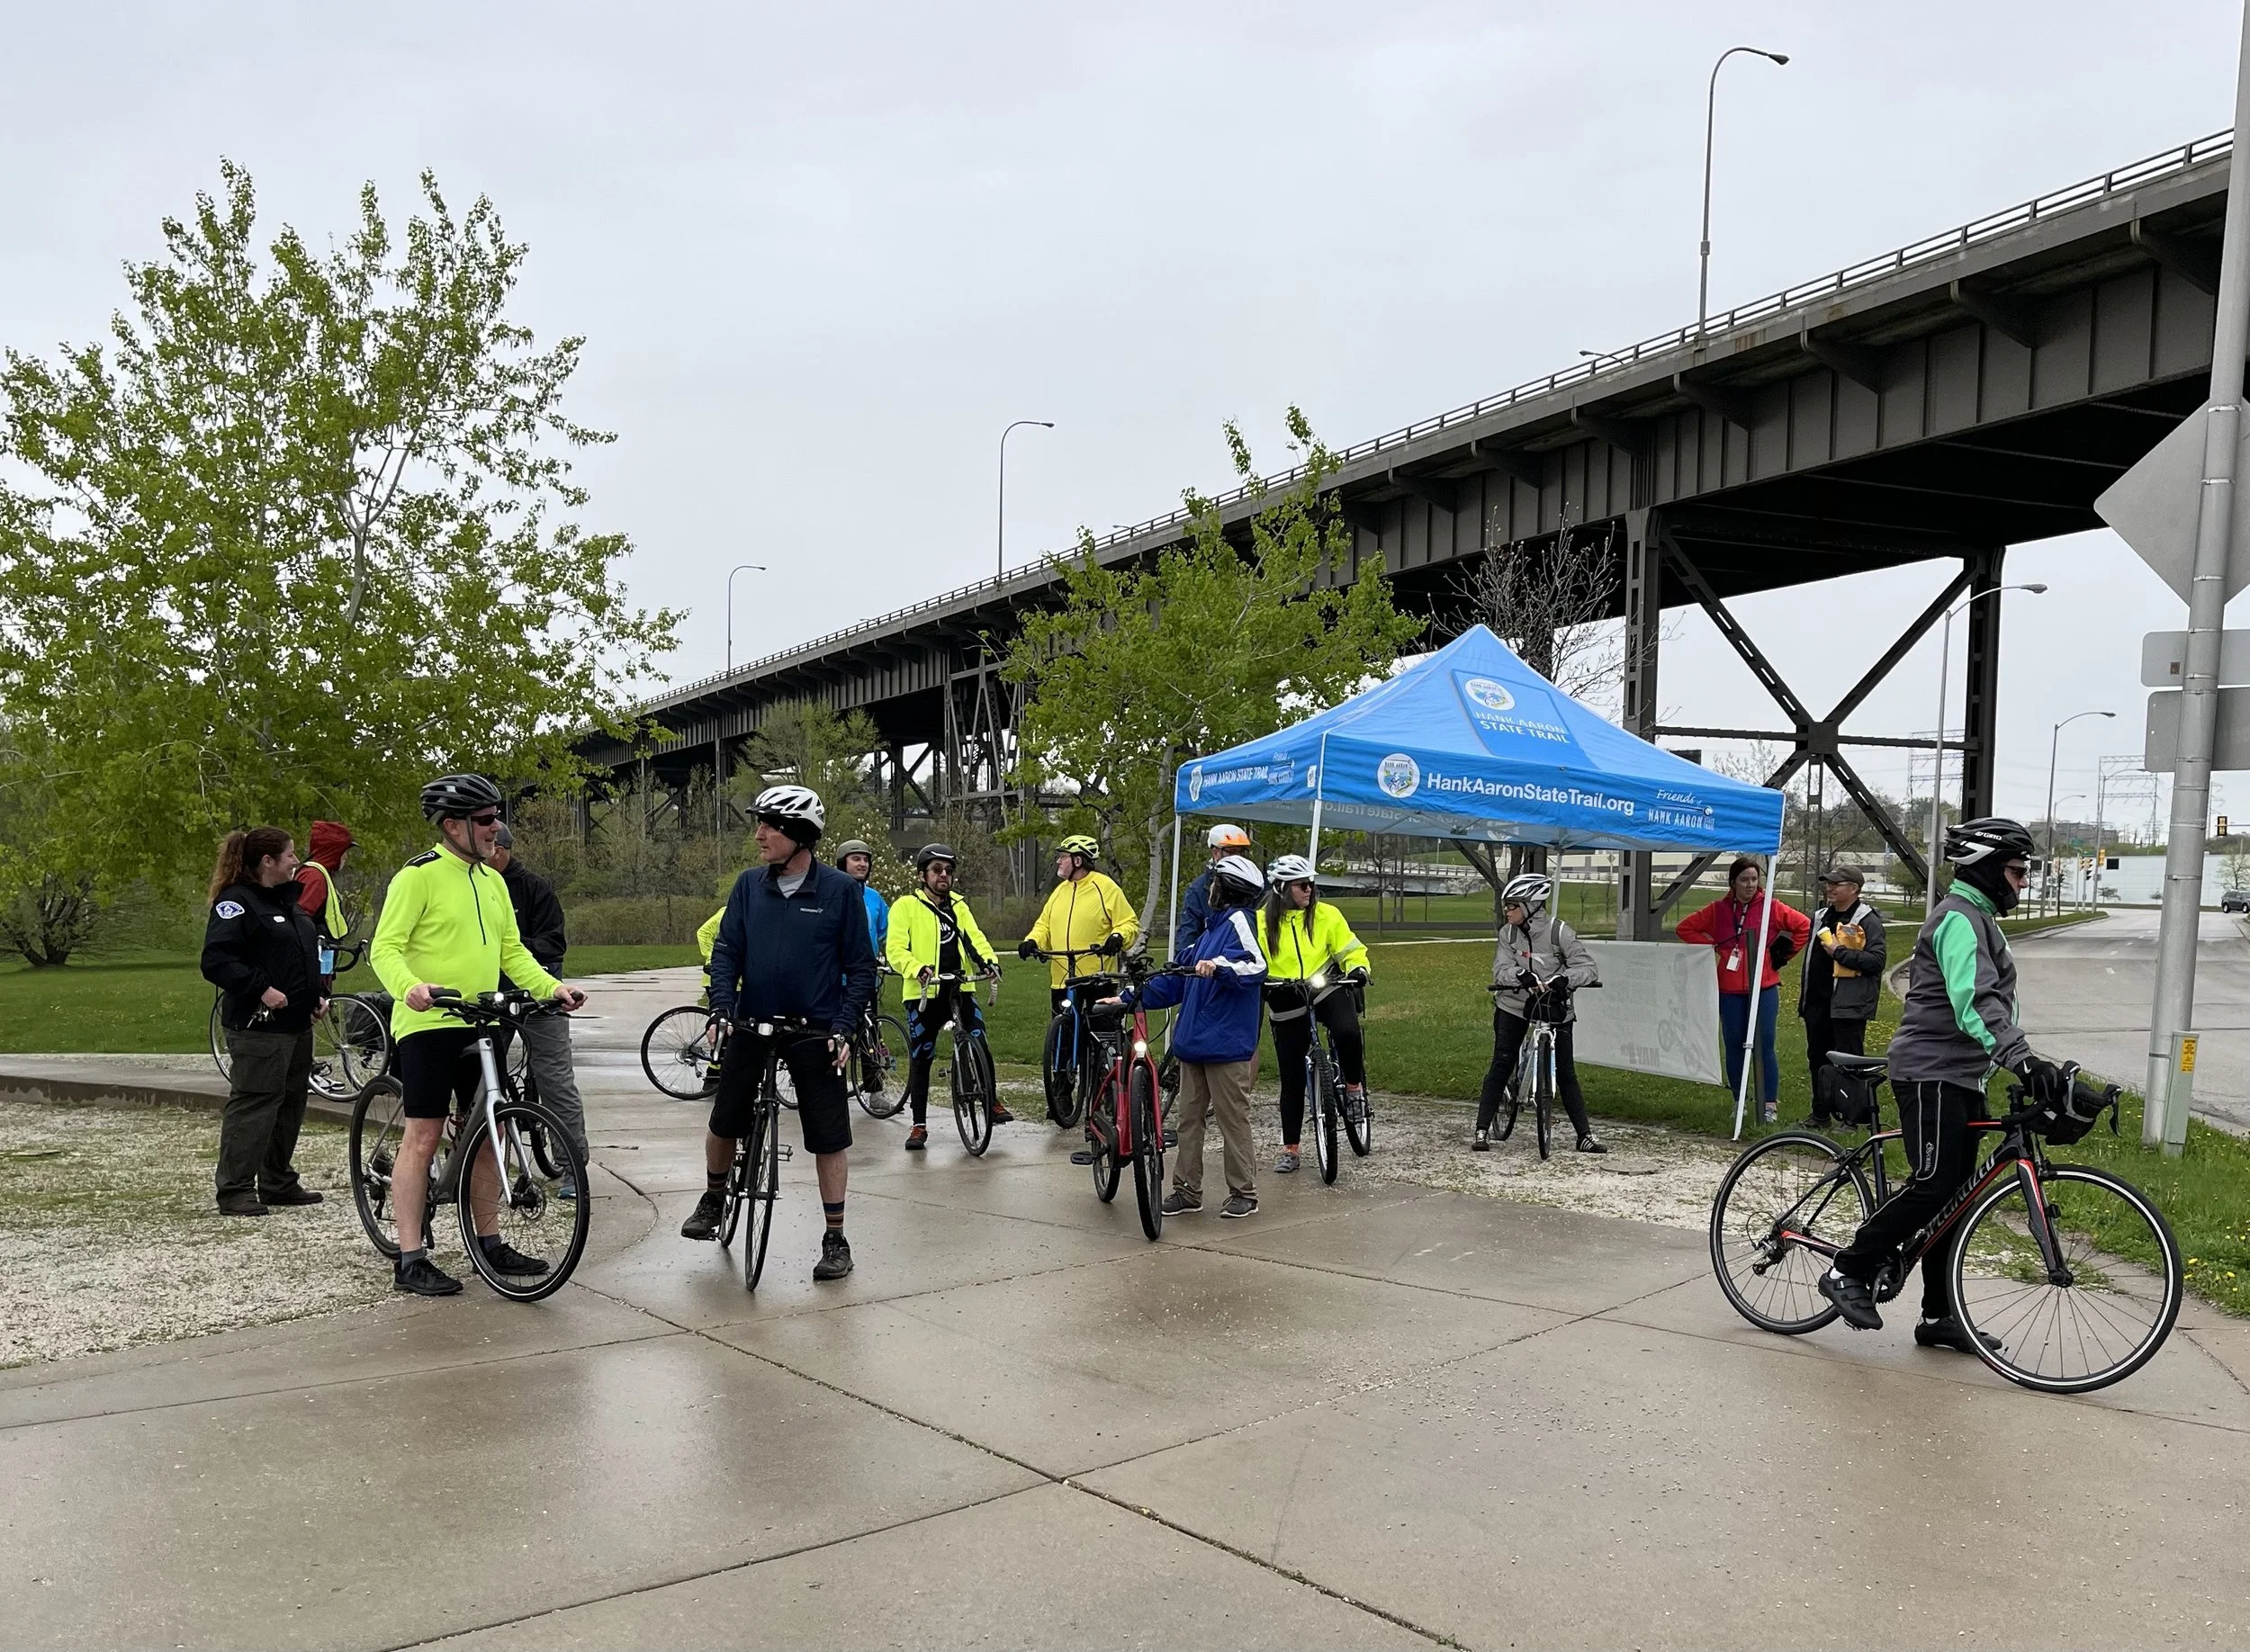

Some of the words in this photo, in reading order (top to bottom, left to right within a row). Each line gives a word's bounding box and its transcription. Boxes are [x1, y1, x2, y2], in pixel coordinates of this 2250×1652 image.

[1475, 711, 1516, 725] HANK
[1517, 718, 1570, 734] AARON
[1480, 720, 1526, 735] STATE
[1526, 727, 1570, 743] TRAIL
[1236, 767, 1254, 782] STATE
[1427, 772, 1635, 816] HankAaronStateTrail.org
[1657, 788, 1696, 804] Friends
[1648, 808, 1671, 825] HANK
[1673, 813, 1704, 829] AARON
